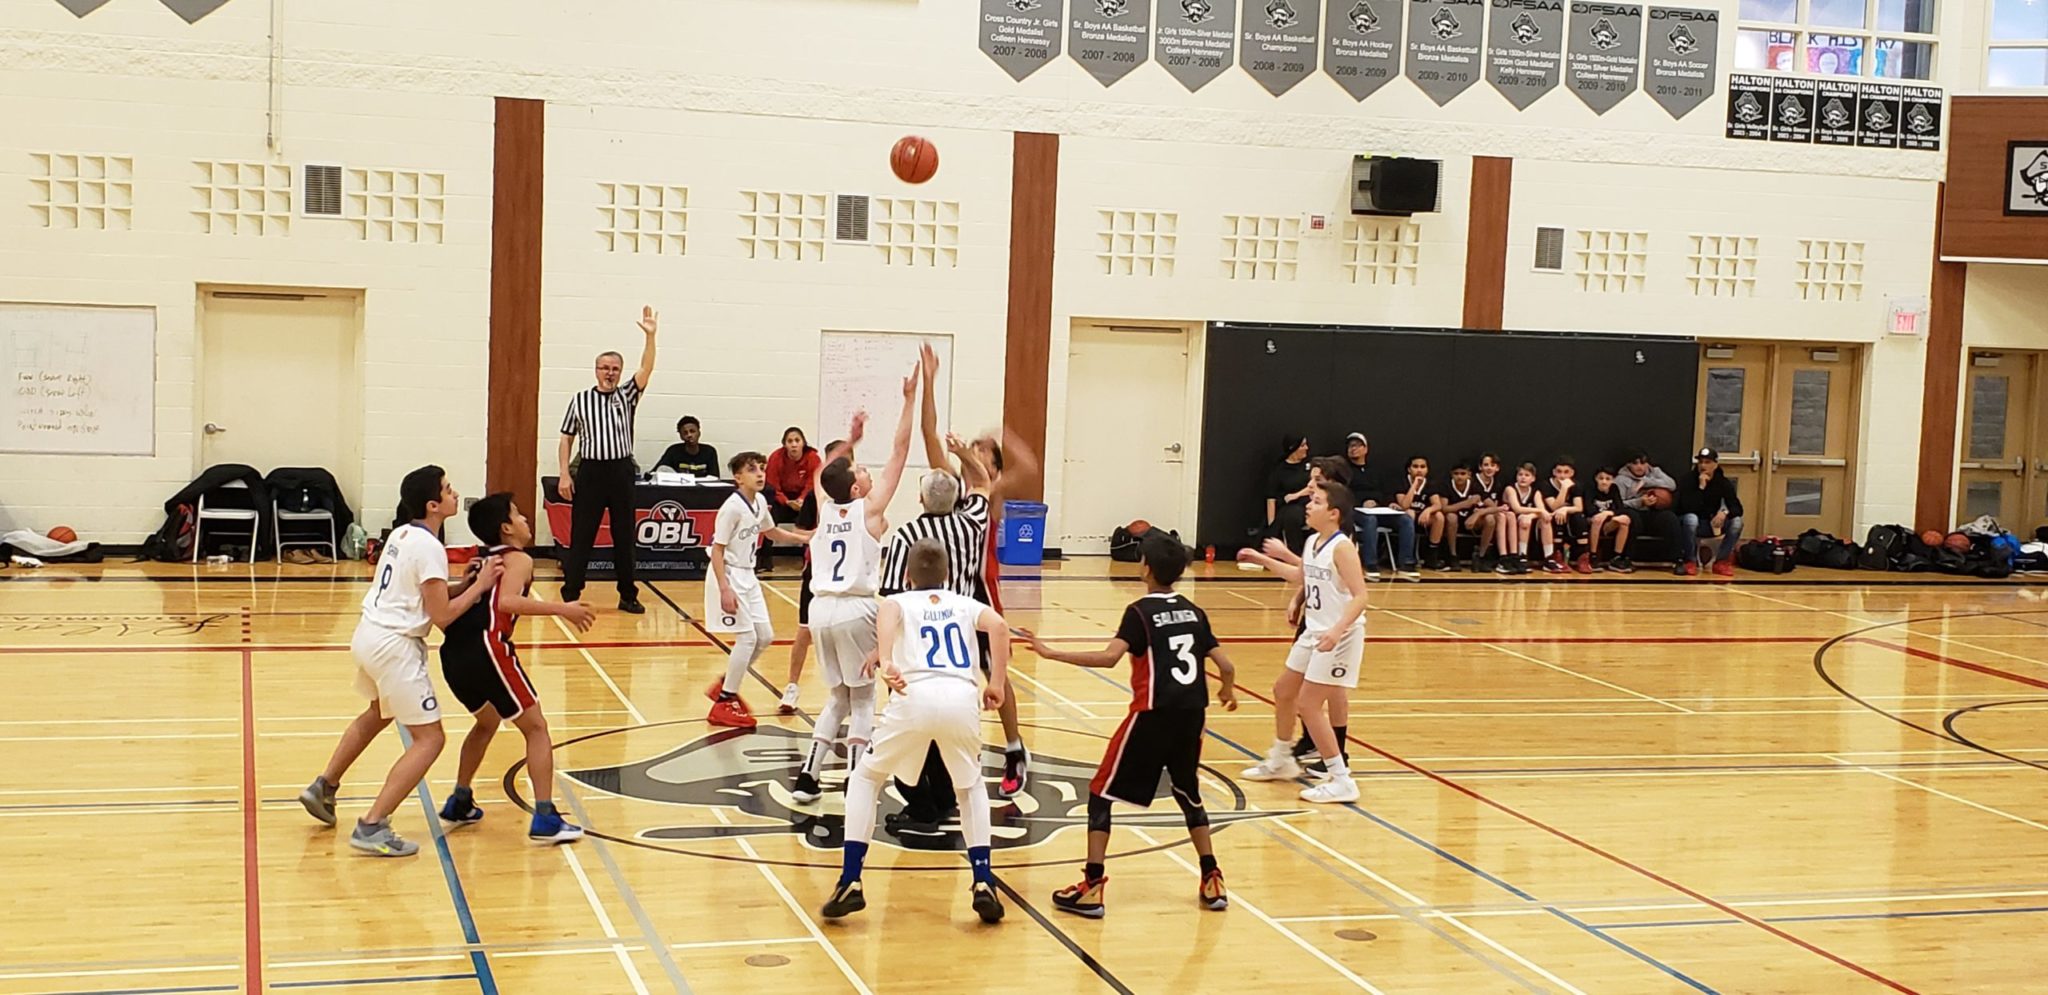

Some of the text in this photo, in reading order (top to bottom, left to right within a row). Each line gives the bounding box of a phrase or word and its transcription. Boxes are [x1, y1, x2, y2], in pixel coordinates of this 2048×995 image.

[1571, 4, 1642, 17] OFSAA
[1649, 9, 1718, 23] OFSAA
[985, 14, 1004, 22] Cross
[1006, 16, 1032, 26] Country
[1043, 19, 1058, 27] Girls
[999, 25, 1043, 36] Gold Medalist
[1084, 21, 1100, 31] Boys
[1113, 24, 1146, 32] Basketball
[991, 34, 1050, 47] Colleen Hennessy
[1082, 31, 1105, 39] Bronze
[1255, 33, 1271, 41] Boys
[1182, 38, 1204, 47] Bronze
[1262, 43, 1297, 52] Champions
[1342, 39, 1357, 48] Boys
[1370, 41, 1393, 51] Hockey
[1420, 44, 1435, 52] Boys
[993, 45, 1016, 56] 2007
[1025, 48, 1047, 58] 2008
[1082, 50, 1104, 59] 2007
[1113, 52, 1135, 62] 2008
[1336, 48, 1357, 56] Bronze
[1418, 53, 1439, 61] Bronze
[1168, 56, 1190, 65] 2007
[1199, 58, 1220, 67] 2008
[1253, 61, 1275, 71] 2008
[1283, 63, 1304, 72] 2009
[1688, 61, 1708, 69] Soccer
[1336, 66, 1357, 76] 2008
[1365, 68, 1386, 77] 2009
[1418, 71, 1439, 80] 2009
[1447, 72, 1468, 81] 2010
[1498, 76, 1518, 85] 2009
[1526, 78, 1546, 86] 2010
[1578, 81, 1598, 89] 2009
[1606, 82, 1625, 91] 2010
[1731, 75, 1770, 86] HALTON
[1775, 79, 1814, 89] HALTON
[1657, 85, 1676, 95] 2010
[1684, 87, 1702, 96] 2011
[1819, 82, 1857, 92] HALTON
[1862, 84, 1900, 95] HALTON
[1904, 88, 1941, 98] HALTON
[638, 521, 697, 544] OBL
[831, 539, 846, 582] 2
[920, 622, 971, 668] 20
[1168, 633, 1198, 685] 3
